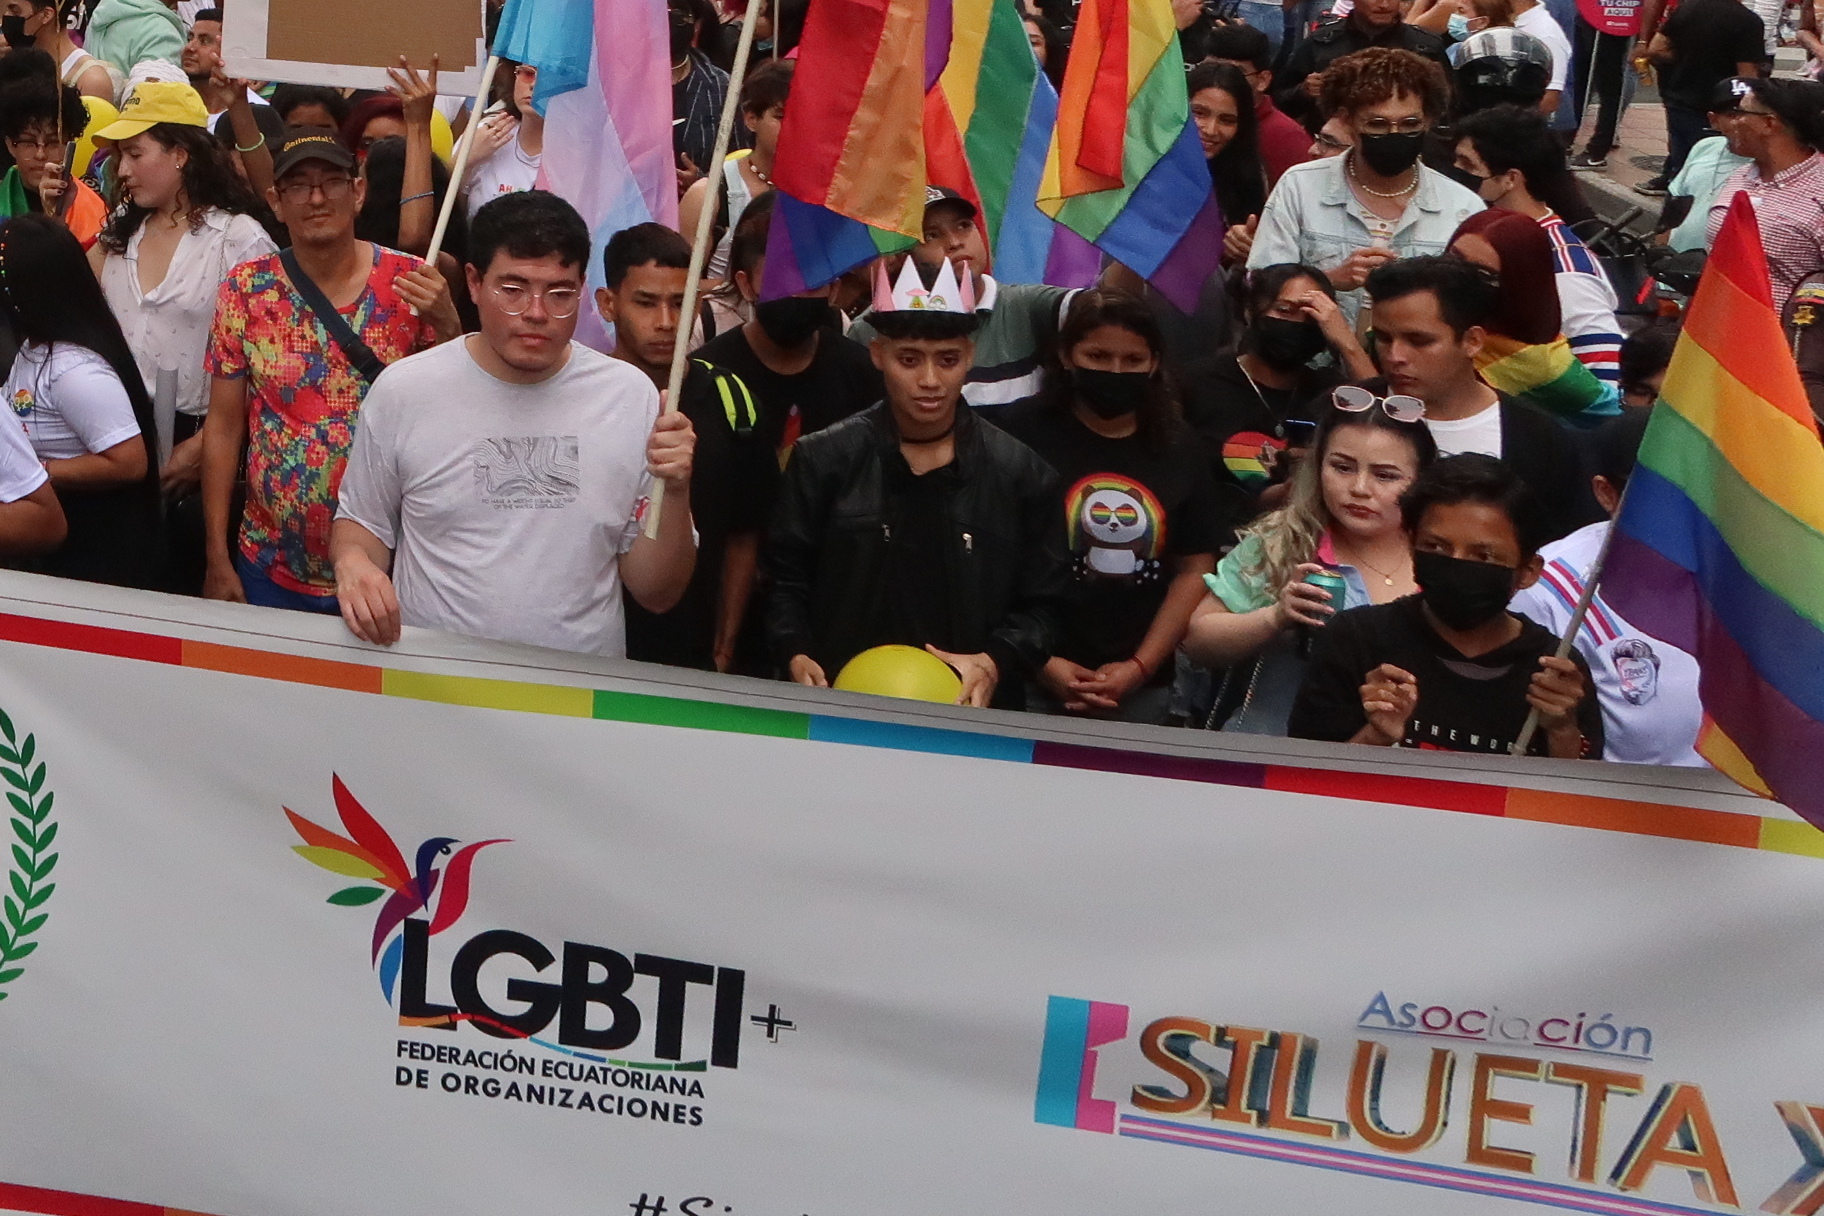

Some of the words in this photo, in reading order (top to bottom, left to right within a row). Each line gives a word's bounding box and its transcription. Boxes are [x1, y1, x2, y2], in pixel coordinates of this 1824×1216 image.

[1414, 719, 1457, 741] THE
[1359, 990, 1654, 1055] Asociación
[395, 1066, 429, 1090] DE
[441, 1071, 704, 1127] ORGANIZACIONES
[396, 1040, 536, 1077] FEDERACIÓN
[542, 1059, 705, 1099] ECUATORIANA
[1130, 1015, 1740, 1210] SILUETA
